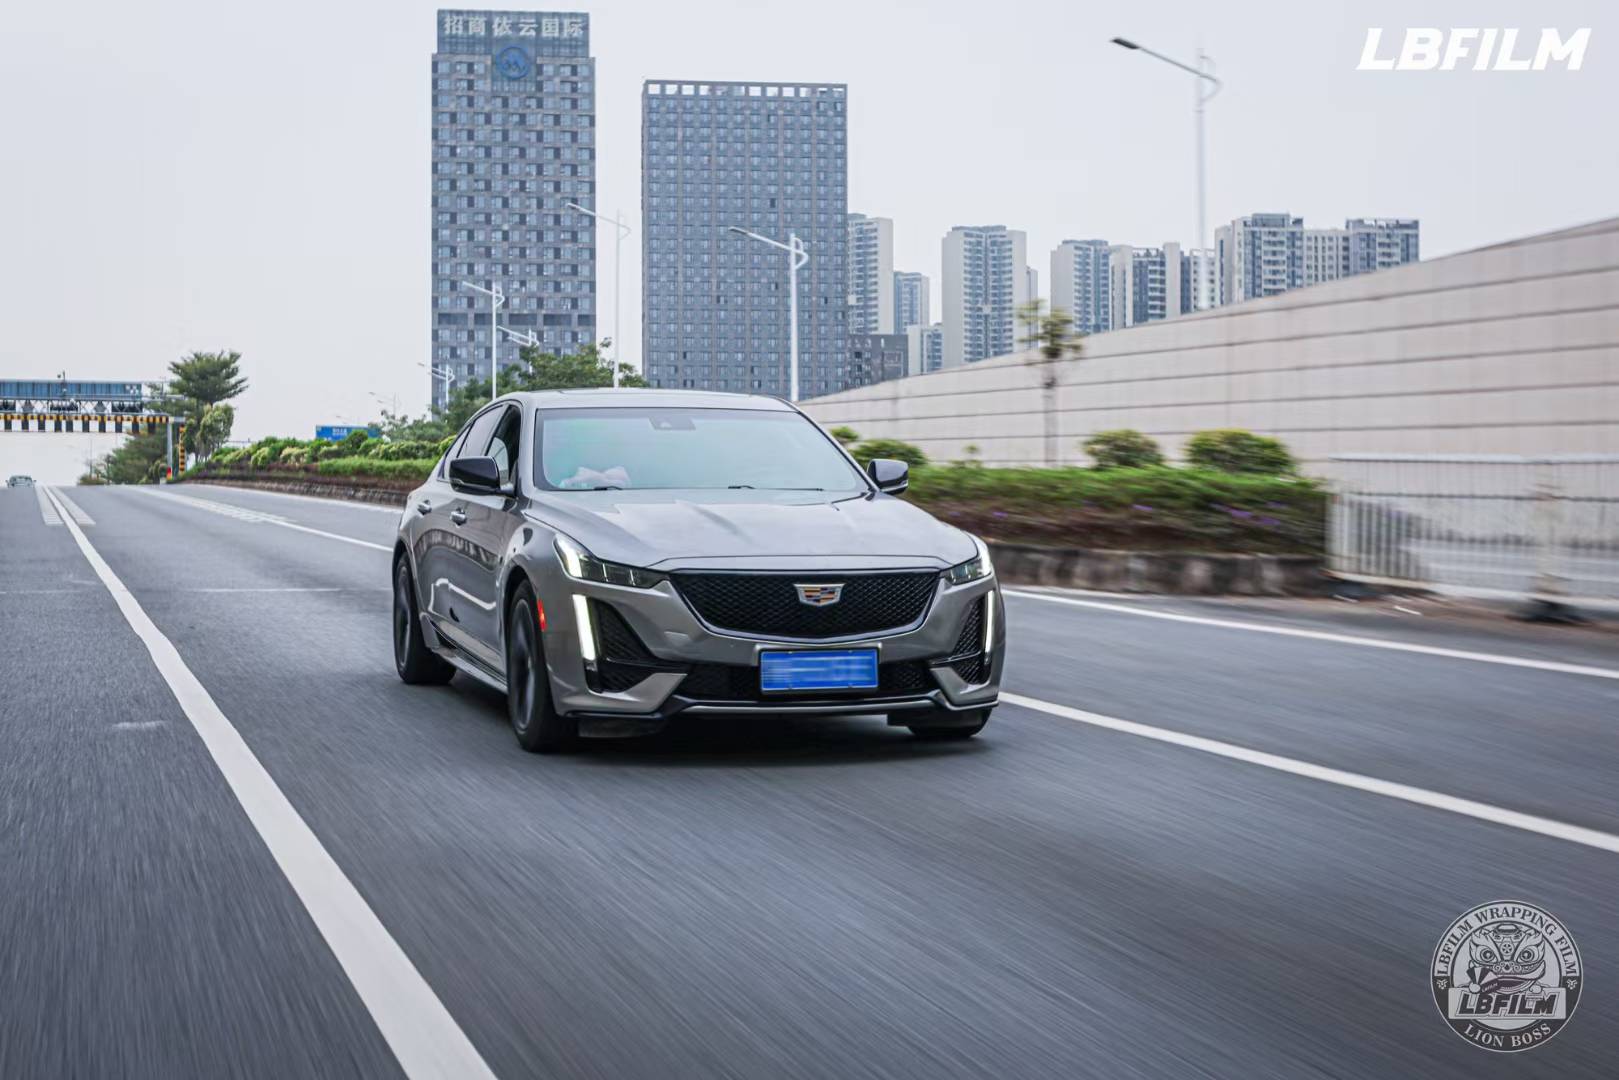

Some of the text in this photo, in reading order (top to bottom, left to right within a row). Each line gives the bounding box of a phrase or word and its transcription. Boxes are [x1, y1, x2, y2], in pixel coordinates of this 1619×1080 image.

[444, 16, 583, 37] 招商依云国际
